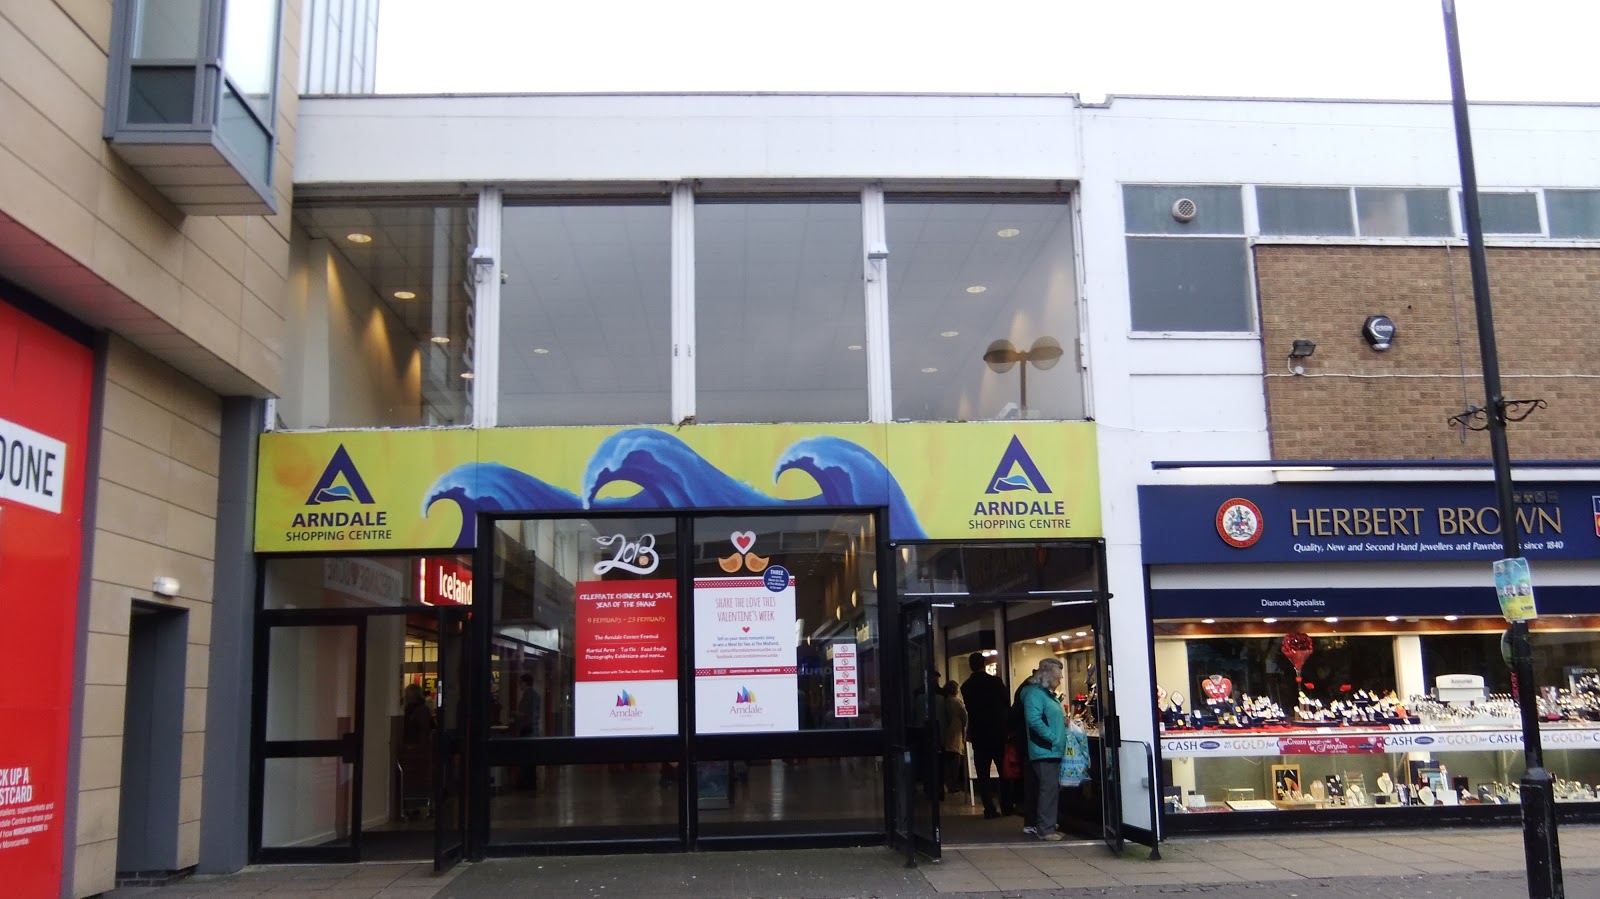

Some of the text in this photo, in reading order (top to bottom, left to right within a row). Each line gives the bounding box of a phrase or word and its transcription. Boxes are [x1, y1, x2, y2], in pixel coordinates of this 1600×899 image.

[973, 501, 1066, 516] ARNDALE
[291, 511, 388, 528] ARNDALE
[968, 519, 1071, 530] SHOPPING CENTRE
[1291, 507, 1425, 537] HERBERT
[1438, 506, 1562, 536] BROWN
[286, 530, 392, 542] SHOPPING CENTRE
[1293, 542, 1324, 553] Quality,
[1326, 543, 1345, 551] New
[1347, 542, 1363, 551] and
[1365, 542, 1394, 551] Second
[1396, 542, 1418, 551] Hand
[1419, 542, 1453, 552] Jewellers
[1455, 542, 1471, 551] and
[1523, 541, 1543, 550] since
[1546, 540, 1564, 550] 1840
[592, 533, 659, 575] 2013
[439, 565, 472, 605] Iceland
[734, 597, 745, 608] THE
[745, 597, 761, 608] LOVE
[762, 596, 776, 607] THIS
[1292, 598, 1325, 608] Specialists
[758, 610, 775, 622] WEEK
[609, 708, 643, 718] Arndale
[730, 705, 763, 715] Arndale
[1286, 738, 1306, 746] Create
[1384, 736, 1412, 746] CASH
[1447, 734, 1478, 745] GOLD
[1489, 734, 1517, 744] CASH
[1551, 732, 1583, 743] GOLD
[1167, 741, 1197, 751] CASH
[1233, 739, 1265, 750] GOLD
[10, 767, 22, 786] UP
[23, 766, 30, 785] A
